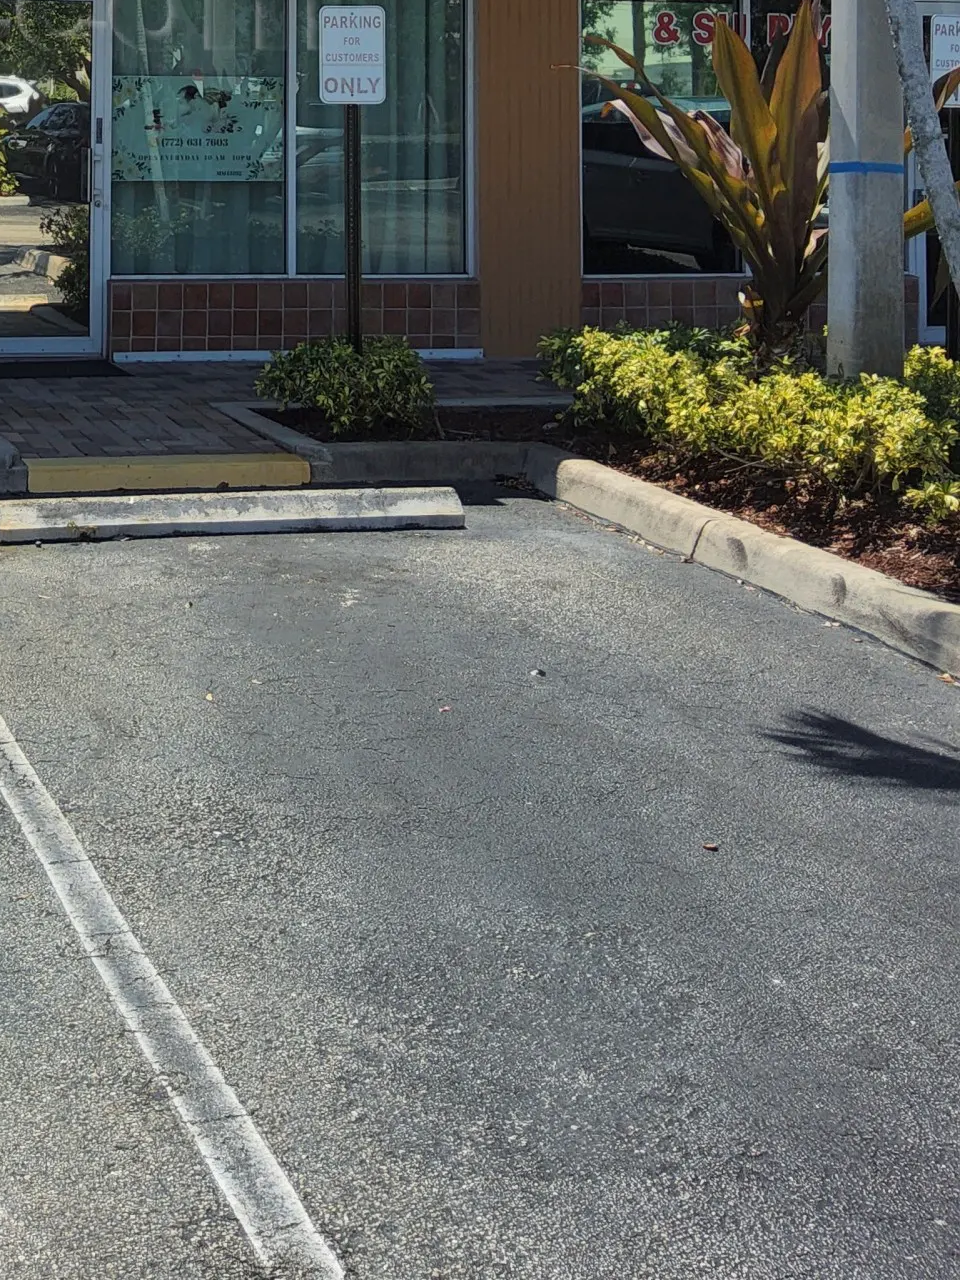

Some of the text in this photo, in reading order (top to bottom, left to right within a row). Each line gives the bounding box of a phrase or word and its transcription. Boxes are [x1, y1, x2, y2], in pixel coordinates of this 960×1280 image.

[323, 15, 381, 29] PARKING
[653, 11, 680, 45] &
[343, 36, 360, 46] FOR
[325, 53, 379, 62] CUSTOMERS
[324, 77, 381, 94] ONLY
